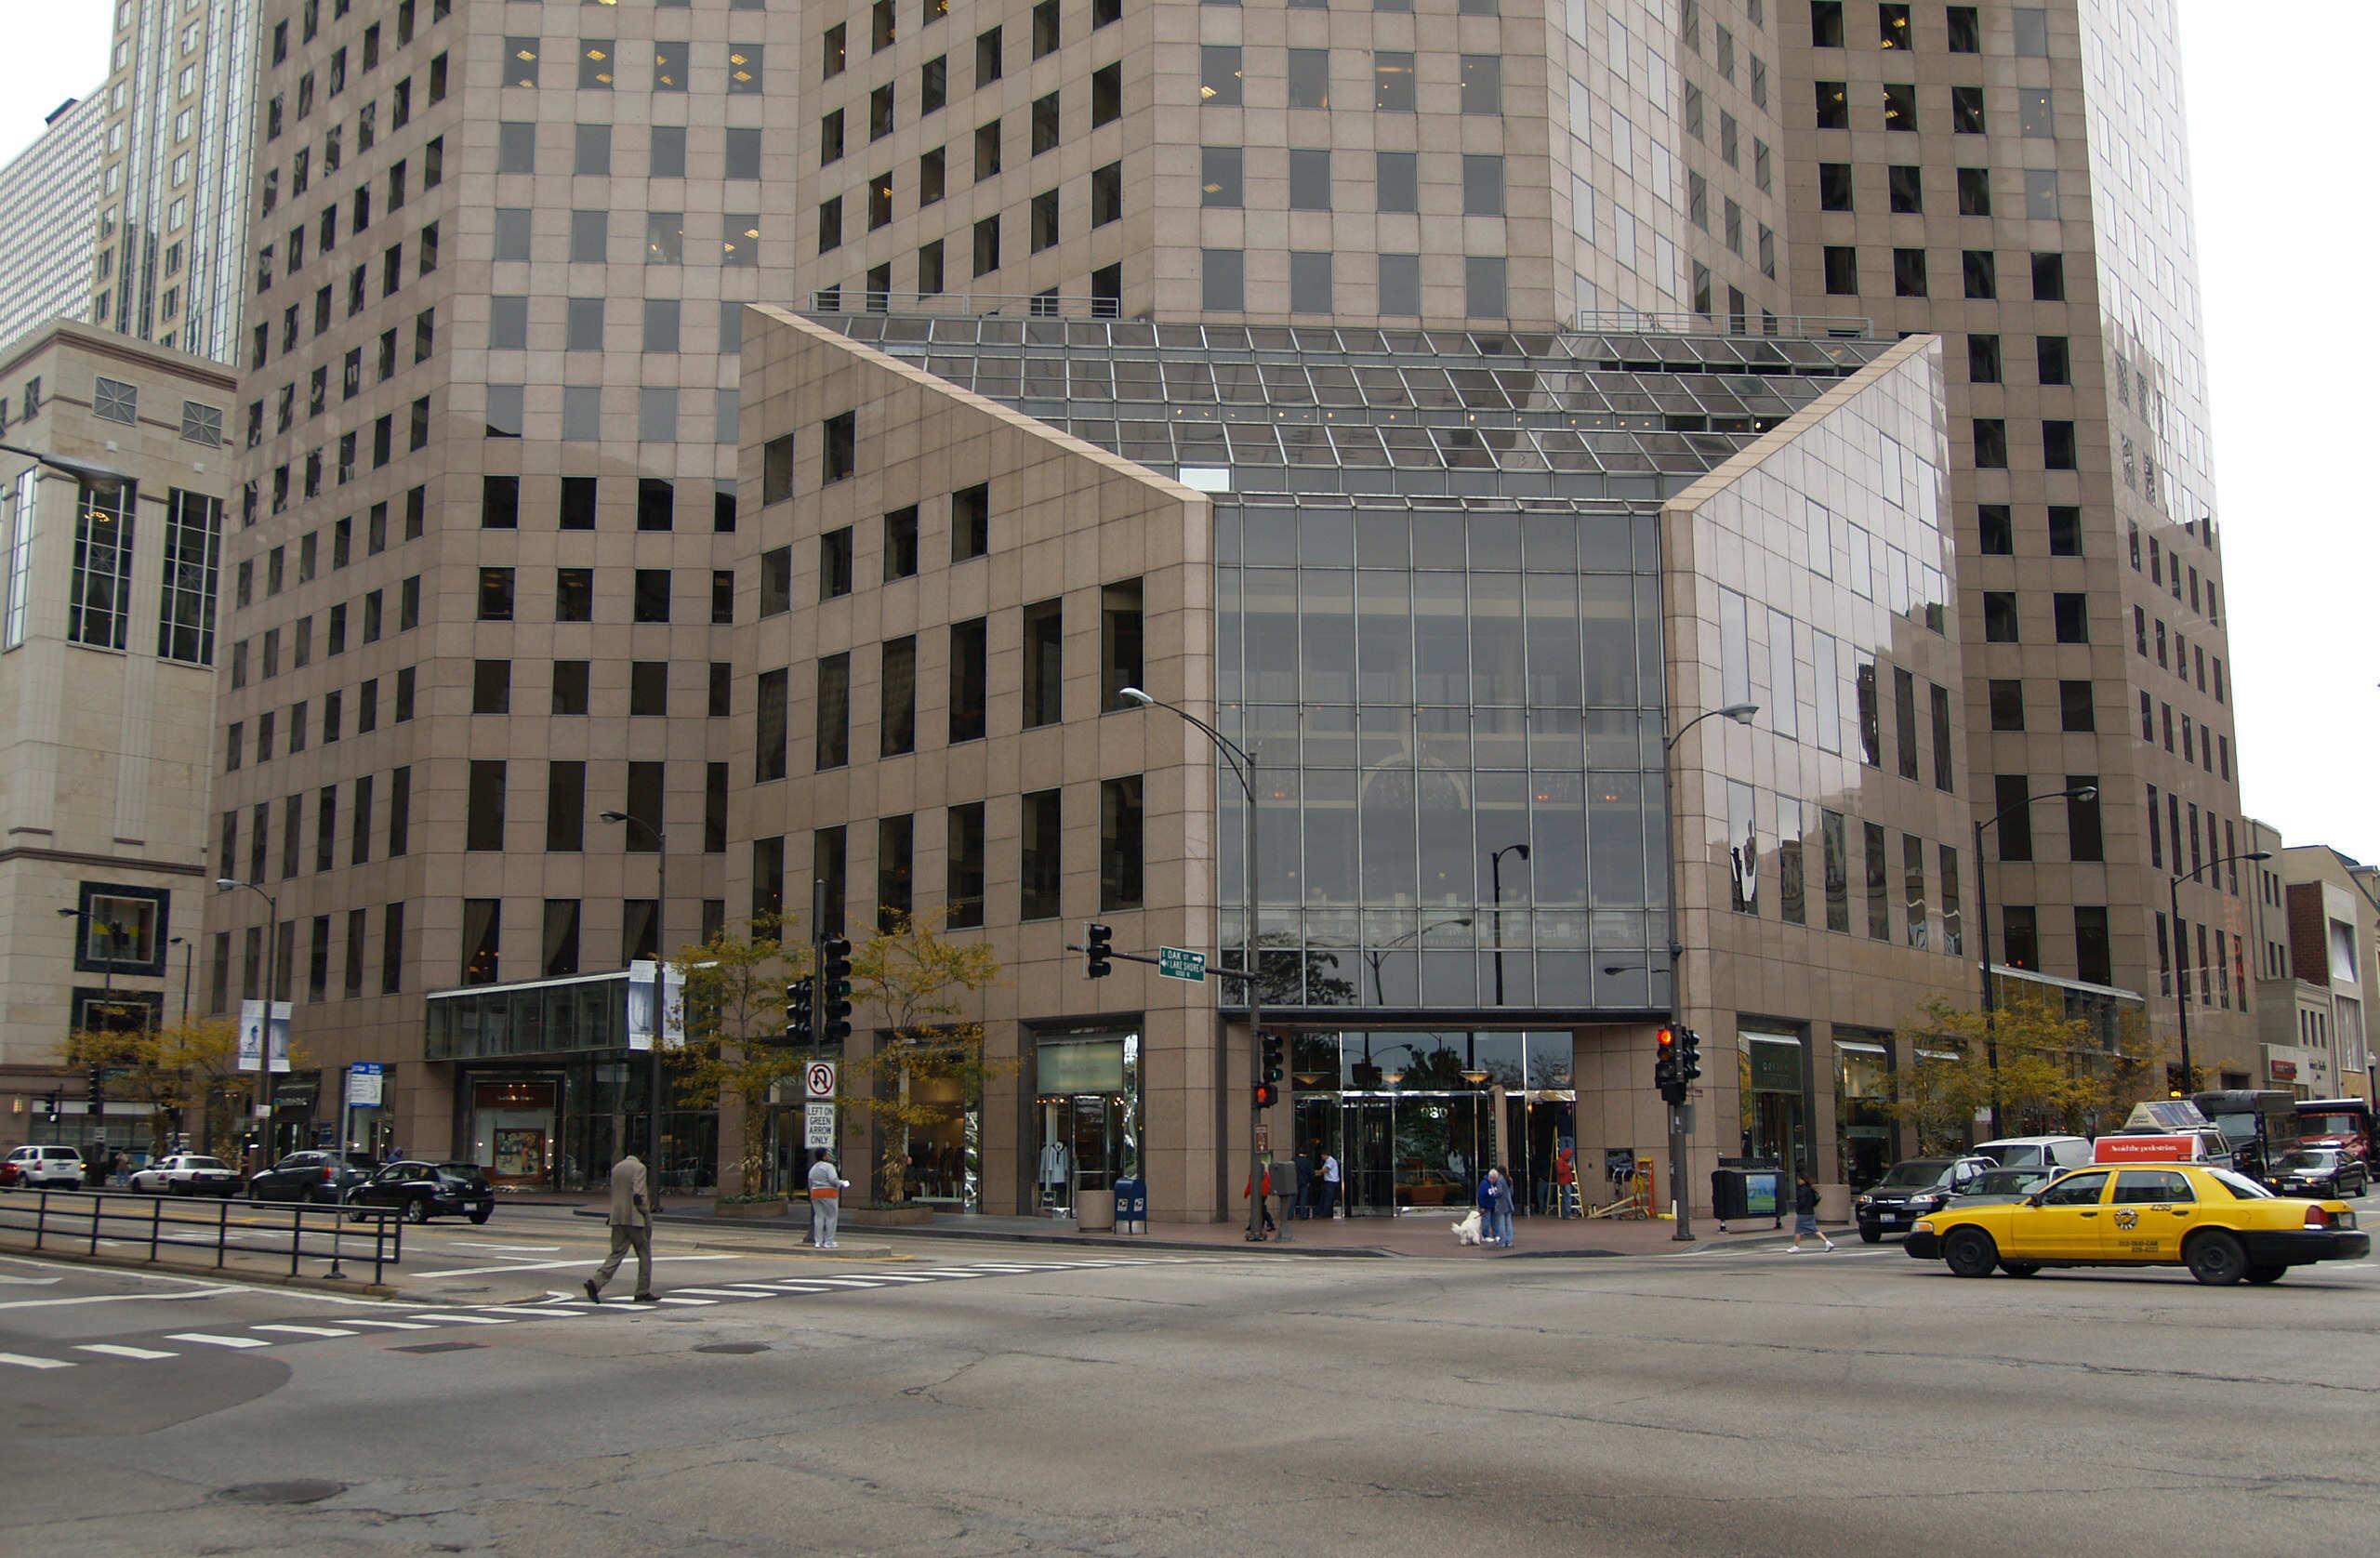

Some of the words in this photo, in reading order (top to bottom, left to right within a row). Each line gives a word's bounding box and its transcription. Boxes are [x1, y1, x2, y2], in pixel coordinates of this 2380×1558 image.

[1168, 949, 1182, 960] OAK
[1170, 959, 1183, 970] LAKE
[1183, 961, 1199, 972] SHORE
[808, 1106, 824, 1116] LEFT
[825, 1106, 833, 1116] ON
[809, 1116, 831, 1125] GREEN
[809, 1126, 832, 1134] ARROW
[810, 1135, 829, 1144] ONLY
